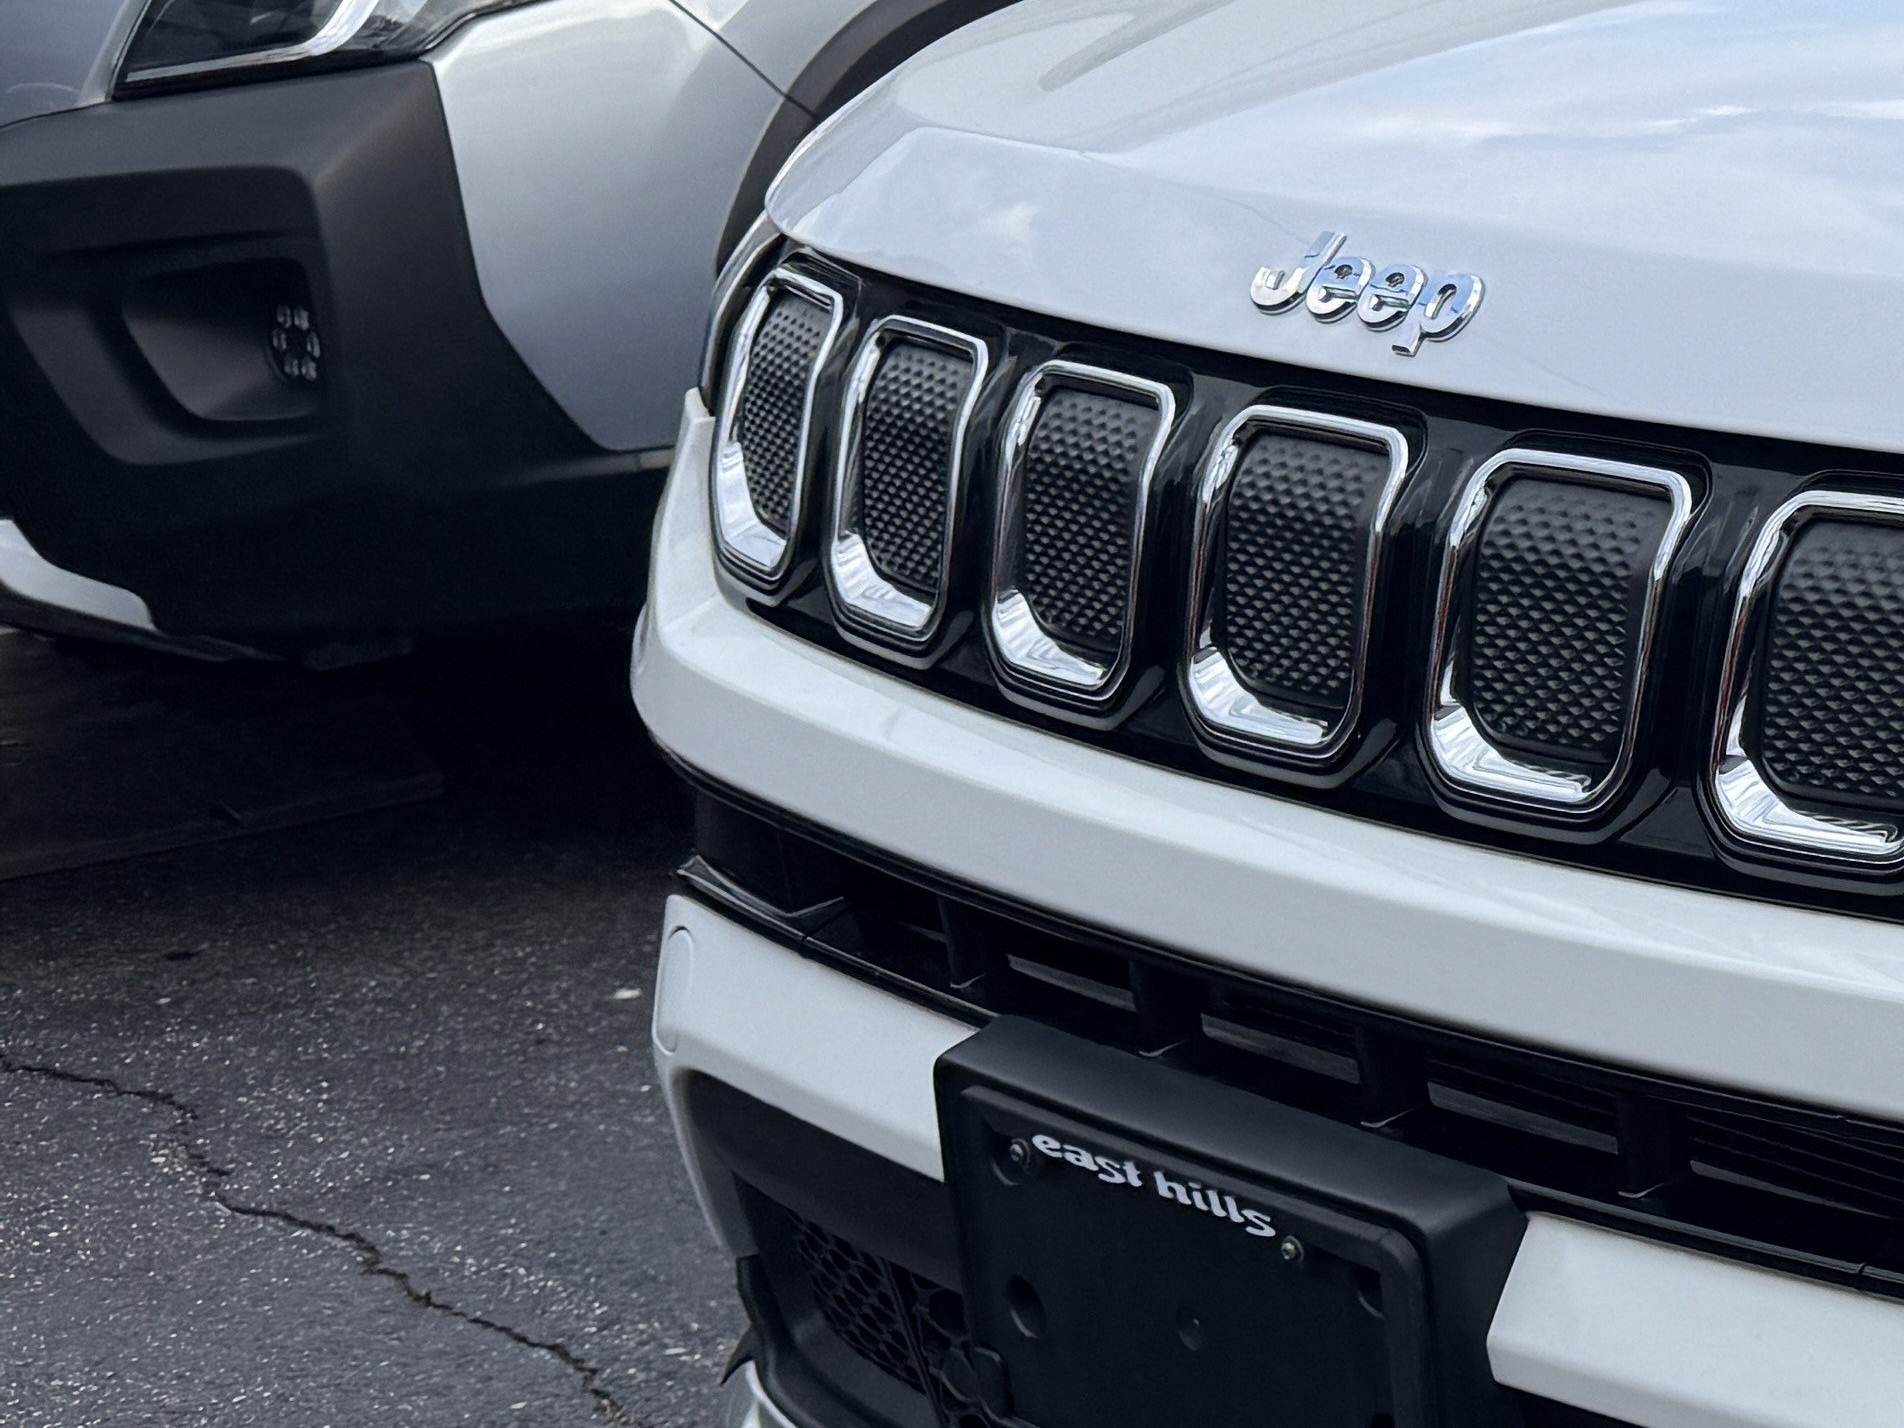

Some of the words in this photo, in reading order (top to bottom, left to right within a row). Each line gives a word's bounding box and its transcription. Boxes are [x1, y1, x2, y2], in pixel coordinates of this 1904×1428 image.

[1250, 230, 1486, 358] Jeep
[1031, 1133, 1142, 1188] east
[1156, 1171, 1276, 1237] hills
